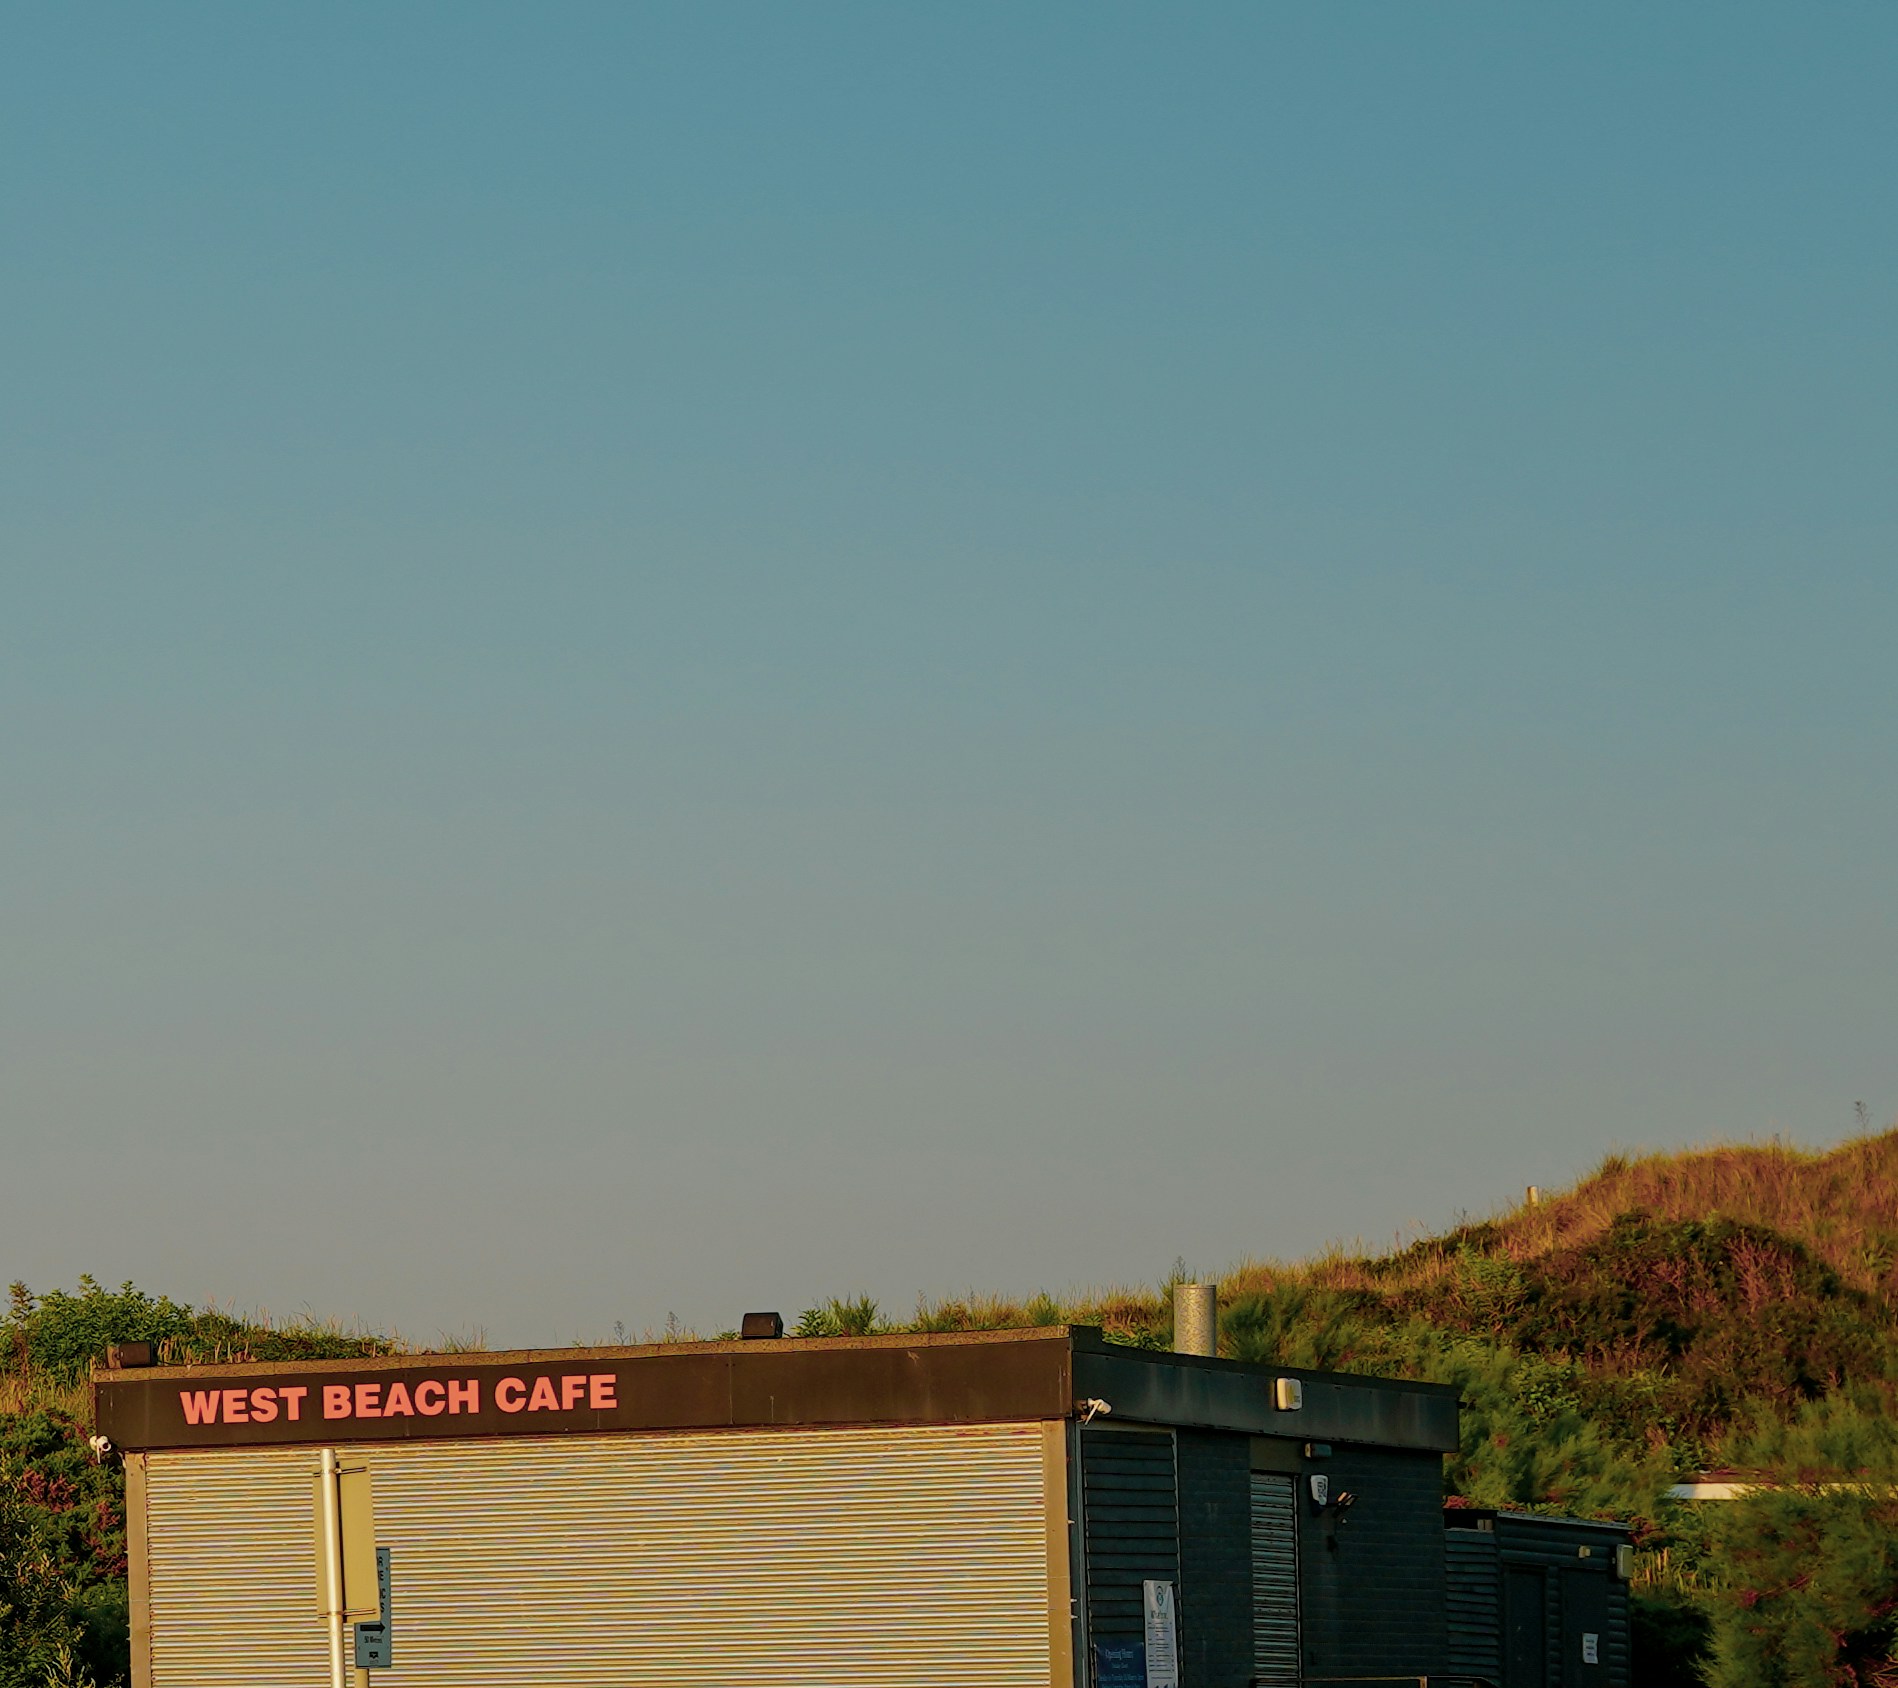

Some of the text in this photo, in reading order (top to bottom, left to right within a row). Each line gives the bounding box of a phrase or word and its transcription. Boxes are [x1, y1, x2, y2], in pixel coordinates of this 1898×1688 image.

[179, 1374, 618, 1425] WEST BEACH CAFE
